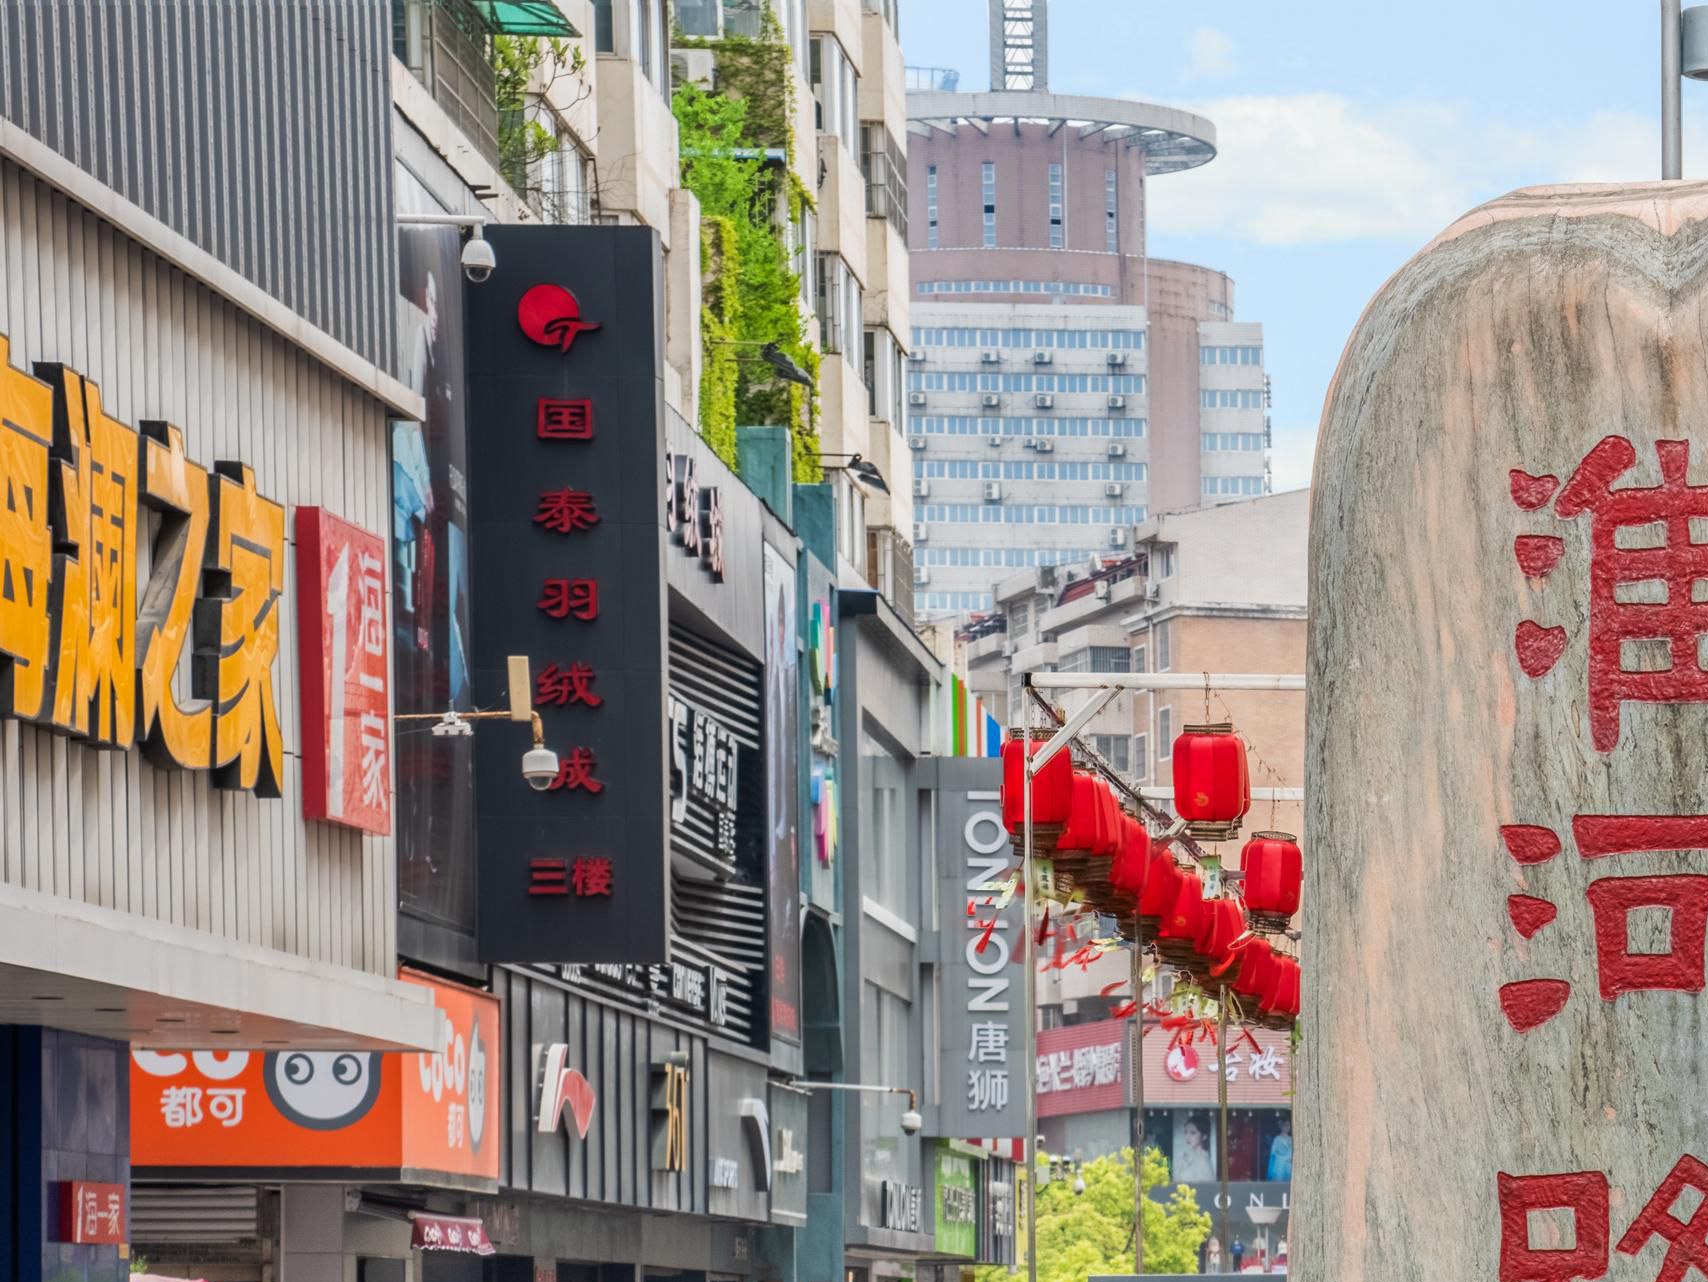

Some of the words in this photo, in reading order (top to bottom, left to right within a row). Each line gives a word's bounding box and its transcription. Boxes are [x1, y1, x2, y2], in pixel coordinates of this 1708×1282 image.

[357, 550, 387, 812] 海一家
[528, 855, 614, 898] 三楼
[968, 1020, 1010, 1112] 唐狮
[160, 1086, 247, 1127] 都可
[85, 1191, 120, 1236] 海一家
